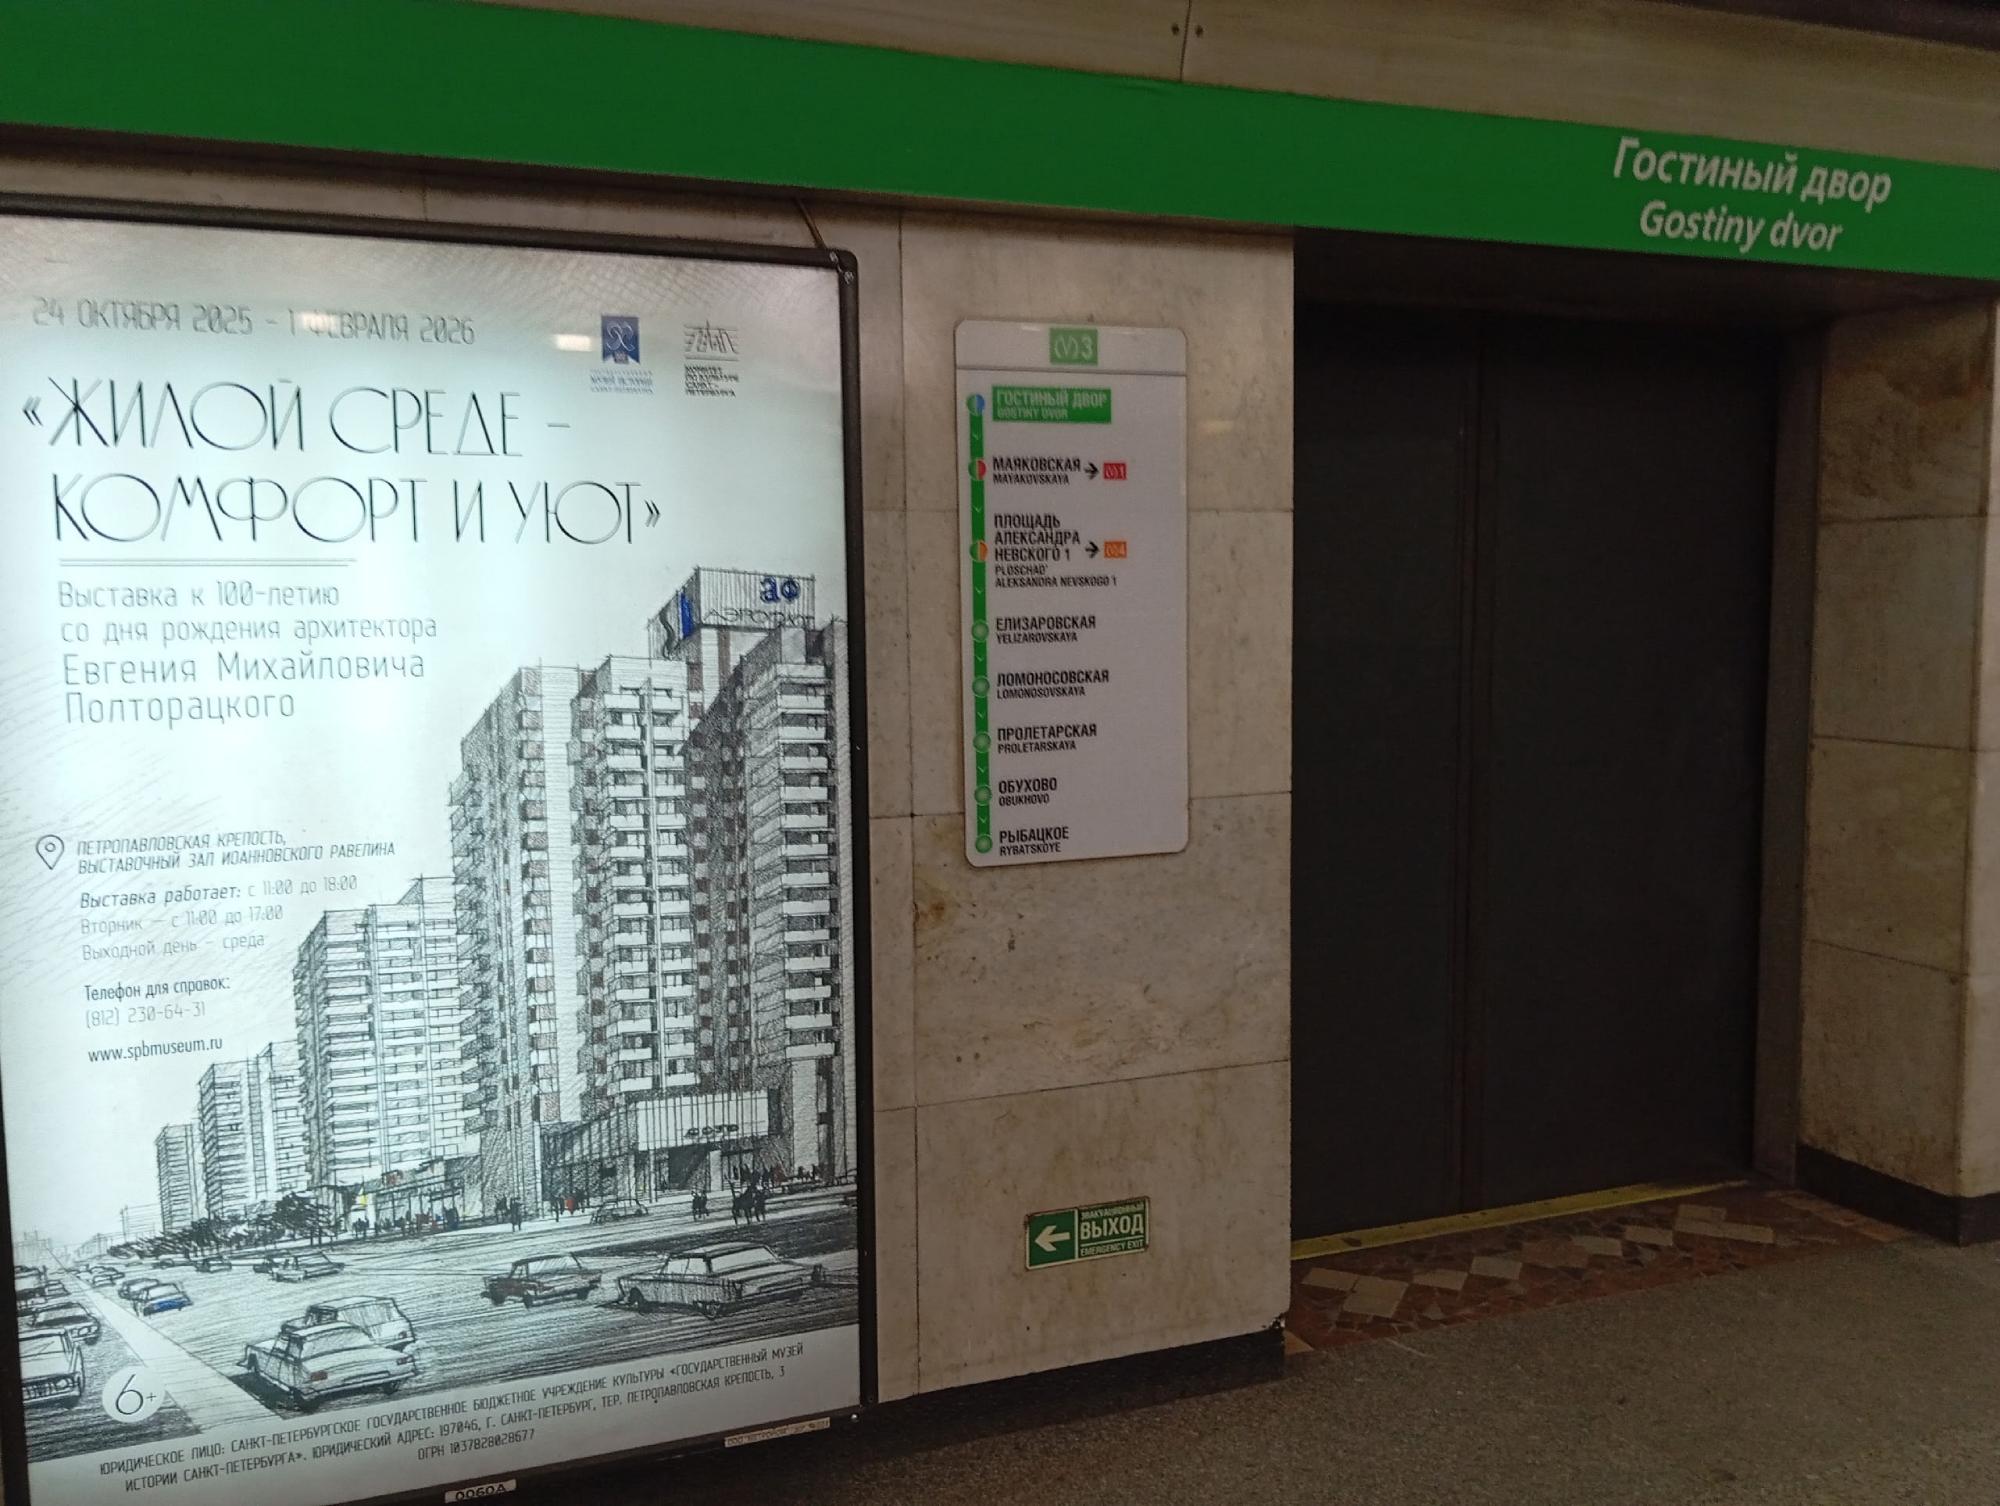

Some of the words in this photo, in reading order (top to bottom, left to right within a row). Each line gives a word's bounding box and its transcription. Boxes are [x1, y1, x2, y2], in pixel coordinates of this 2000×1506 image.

[1613, 136, 1798, 194] Гостиный
[1800, 165, 1891, 213] двор
[1640, 200, 1765, 254] Gostiny
[1770, 211, 1843, 251] dvor
[33, 297, 64, 327] 24
[77, 299, 181, 331] ОКТЯБРЯ
[193, 303, 253, 335] 2025
[288, 308, 296, 337] 1
[420, 315, 475, 345] 2026
[997, 388, 1068, 407] ГОСТИНЫЙ
[1072, 392, 1107, 409] ДВОР
[22, 376, 304, 452] «ЖИЛОЙ
[329, 386, 524, 456] СРЕДЕ
[992, 456, 1081, 472] МАЯКОВСКАЯ
[993, 473, 1070, 485] MAYAKOVSKAYA
[53, 472, 427, 542] КОМФОРТ
[454, 478, 485, 542] И
[508, 480, 661, 543] УЮТ»
[994, 513, 1060, 530] ПЛОЩАДЬ
[994, 531, 1080, 547] АЛЕКСАНДРА
[995, 548, 1060, 561] НЕВСКОГО
[1065, 548, 1071, 561] 1
[58, 580, 178, 609] Выставка
[191, 585, 204, 606] к
[217, 580, 339, 607] 100-летию
[995, 576, 1058, 588] ALEKSANDRA
[1060, 576, 1109, 586] NEVSKOGO
[62, 621, 89, 643] со
[103, 621, 148, 647] дня
[162, 619, 281, 648] рождения
[294, 616, 436, 645] архитектора
[996, 615, 1096, 631] ЕЛИЗАРОВСКАЯ
[996, 631, 1078, 645] YELIZAROVSKAYA
[63, 653, 196, 686] Евгения
[217, 651, 425, 682] Михайловича
[997, 670, 1109, 687] ЛОМОНОСОВСКАЯ
[997, 686, 1085, 700] LOMONOSOVSKAYA
[65, 691, 295, 729] Полторацкого
[998, 724, 1097, 741] ПРОЛЕТАРСКАЯ
[998, 740, 1077, 754] PROLETARSKAYA
[999, 777, 1057, 794] ОБУХОВО
[999, 793, 1050, 806] OBUKHOVO
[77, 833, 210, 856] ПЕТРОПАВЛОВСКАЯ
[217, 830, 287, 847] КРЕПОСТЬ,
[1000, 827, 1069, 844] РЫБАЦКОЕ
[78, 851, 181, 874] ВЫСТАВОЧНЫЙ
[188, 852, 215, 868] ЗАЛ
[222, 845, 323, 866] ИОАННОВСКОГО
[330, 841, 395, 859] РАВЕЛИНА
[1000, 842, 1061, 856] RYBATSKOYE
[80, 892, 156, 908] Выставка
[164, 884, 241, 907] работает:
[248, 884, 256, 897] с
[263, 879, 293, 896] 11:00
[300, 880, 317, 894] до
[323, 874, 358, 891] 18:00
[81, 918, 142, 936] Вторник
[171, 915, 179, 928] с
[186, 909, 217, 927] 11:00
[225, 911, 242, 925] до
[249, 905, 283, 922] 17:00
[82, 941, 155, 961] Выходной
[163, 941, 197, 956] день
[223, 935, 265, 952] среда
[85, 982, 141, 1002] Телефон
[145, 982, 169, 998] для
[174, 977, 231, 997] справок:
[86, 1007, 120, 1029] (812)
[128, 1001, 205, 1023] 230-64-31
[88, 1037, 223, 1062] www.spbmuseum.ru
[1080, 1213, 1144, 1240] ВЫХОД
[115, 1374, 157, 1415] 6+
[100, 1450, 185, 1475] ЮРИДИЧЕСКОЕ
[191, 1443, 225, 1459] ЛИЦО:
[231, 1419, 361, 1453] САНКТ-ПЕТЕРБУРГСКОЕ
[366, 1400, 468, 1429] ГОСУДАРСТВЕННОЕ
[473, 1389, 536, 1412] БЮДЖЕТНОЕ
[542, 1379, 608, 1399] УЧРЕЖДЕНИЕ
[612, 1367, 665, 1386] КУЛЬТУРЫ
[669, 1348, 768, 1376] «ГОСУДАРСТВЕННЫЙ
[772, 1342, 804, 1359] МУЗЕЙ
[125, 1472, 178, 1492] ИСТОРИИ
[312, 1433, 392, 1459] ЮРИДИЧЕСКИЙ
[397, 1427, 435, 1444] АДРЕС:
[439, 1420, 482, 1437] 197046,
[486, 1416, 496, 1429] Г.
[602, 1393, 623, 1408] ТЕР.
[627, 1379, 720, 1403] ПЕТРОПАВЛОВСКАЯ
[724, 1370, 774, 1386] КРЕПОСТЬ,
[779, 1365, 786, 1377] 3
[418, 1447, 445, 1460] ОГРН
[450, 1428, 535, 1454] 1037828028677
